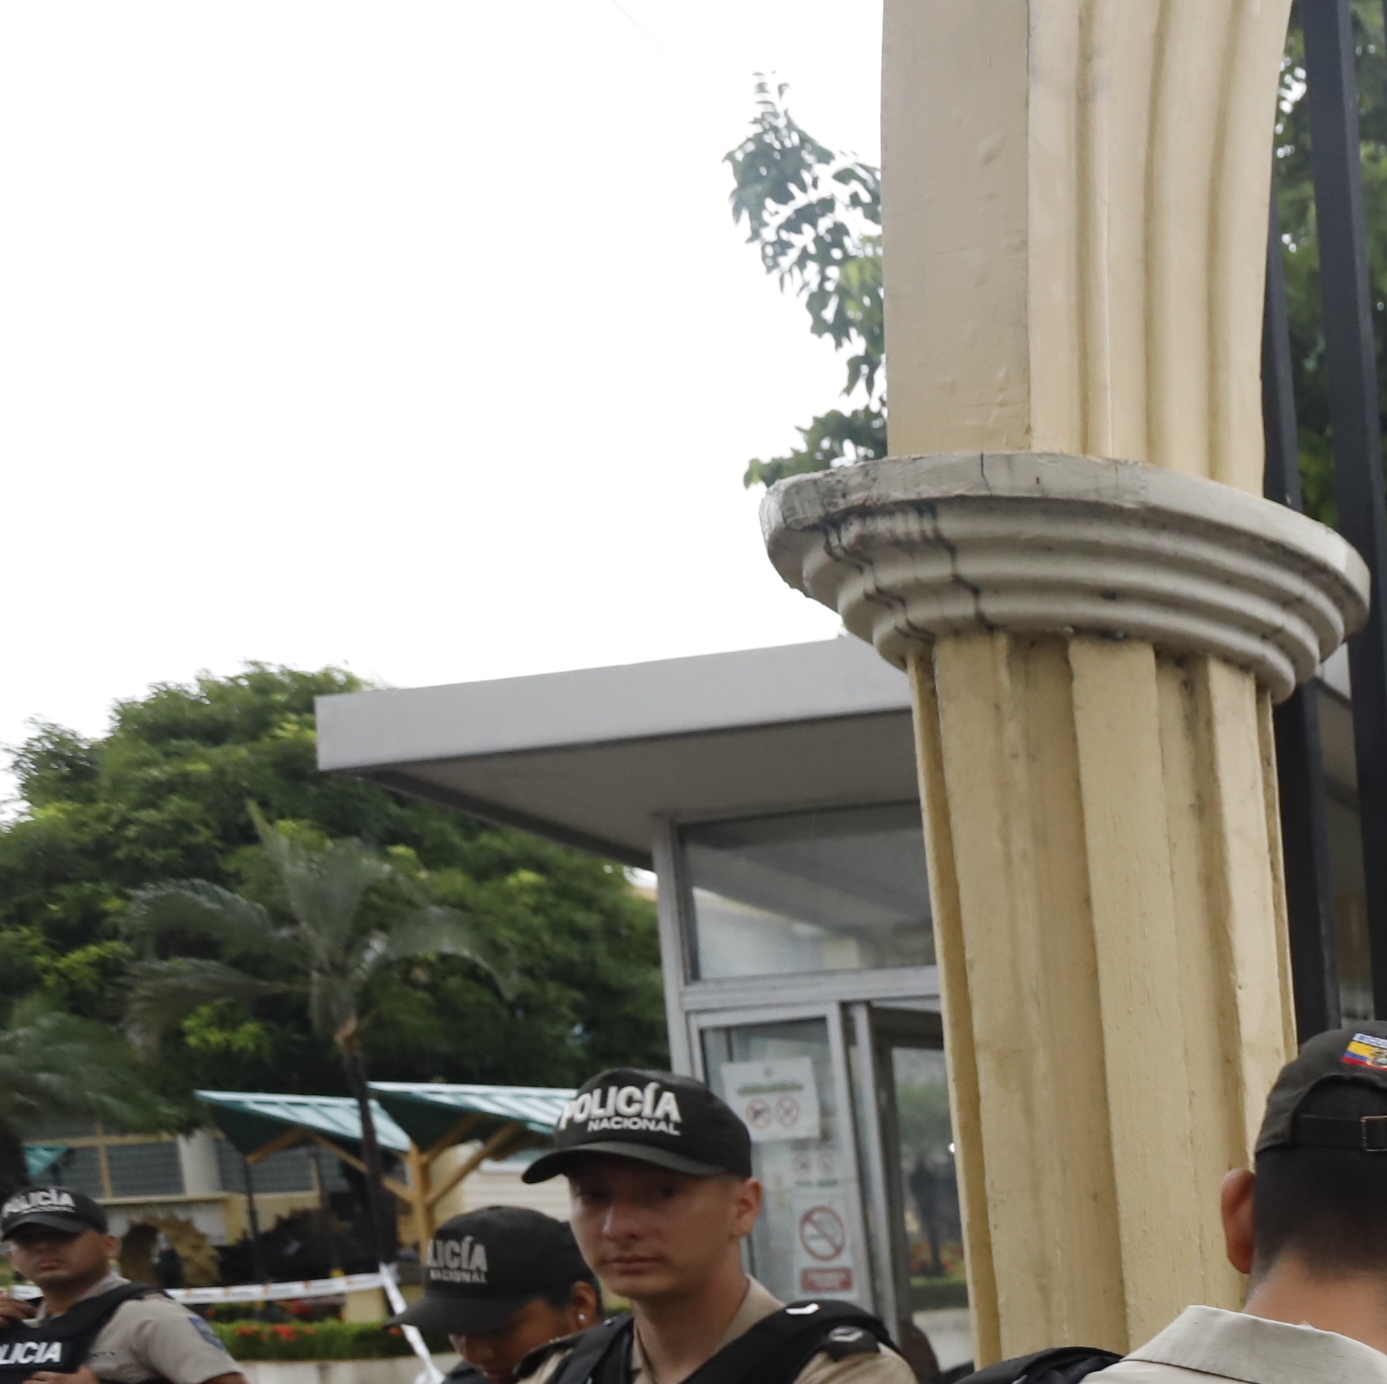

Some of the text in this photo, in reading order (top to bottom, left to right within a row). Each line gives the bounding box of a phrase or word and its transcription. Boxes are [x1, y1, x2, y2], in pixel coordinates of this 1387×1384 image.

[559, 1081, 682, 1131] POLICÍA
[587, 1116, 682, 1136] NACIONAL
[0, 1341, 62, 1365] LICIA
